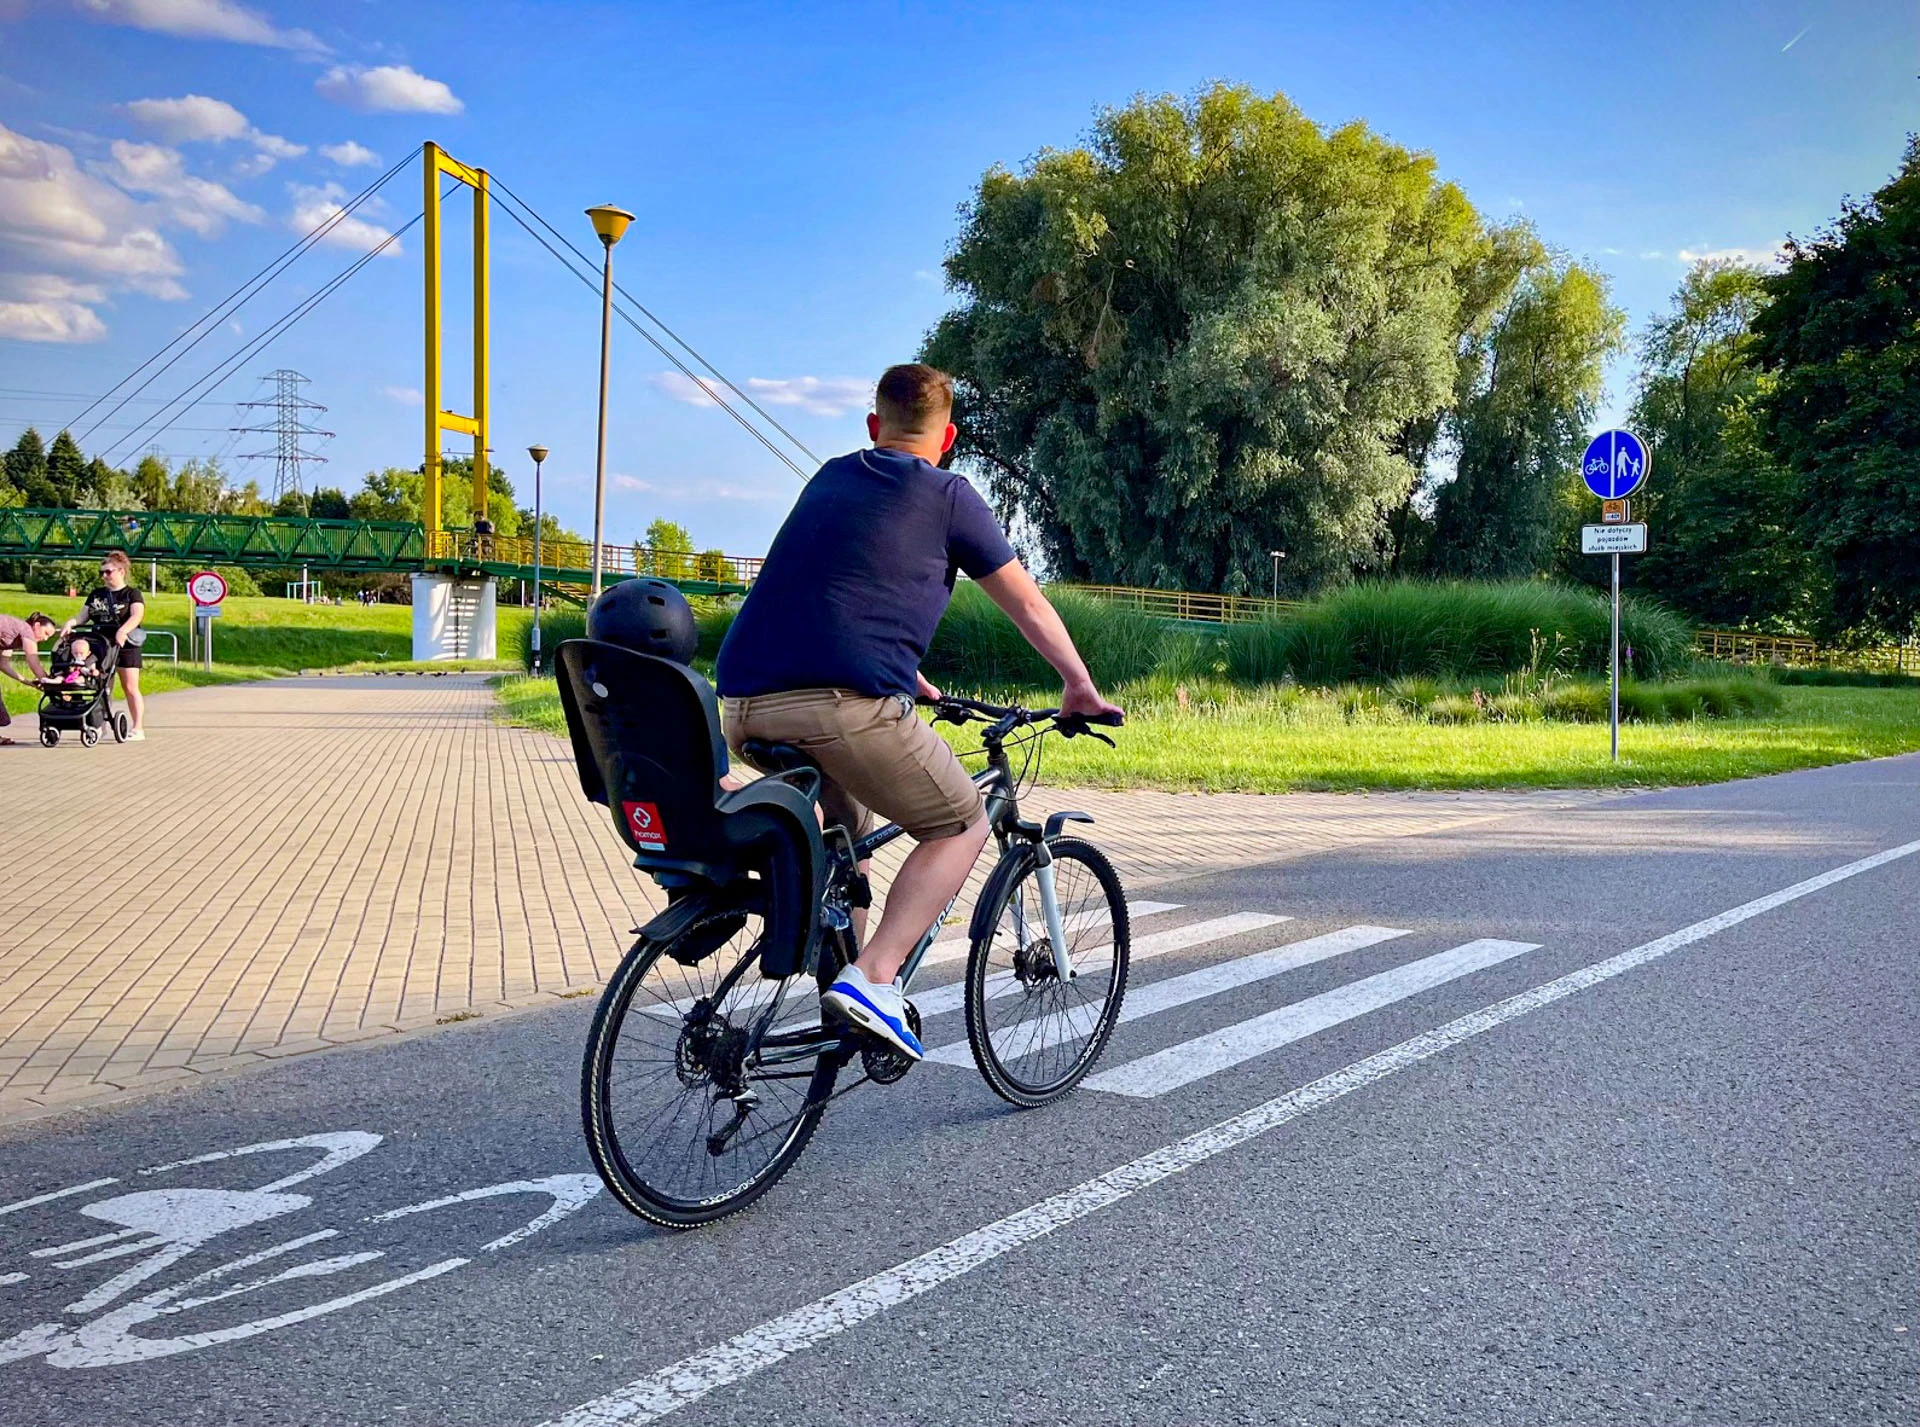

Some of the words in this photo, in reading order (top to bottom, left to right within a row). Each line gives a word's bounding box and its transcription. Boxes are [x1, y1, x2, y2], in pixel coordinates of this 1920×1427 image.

[1607, 527, 1632, 535] dotyczy
[1597, 536, 1628, 544] pojazdów
[1606, 543, 1638, 552] miejskich
